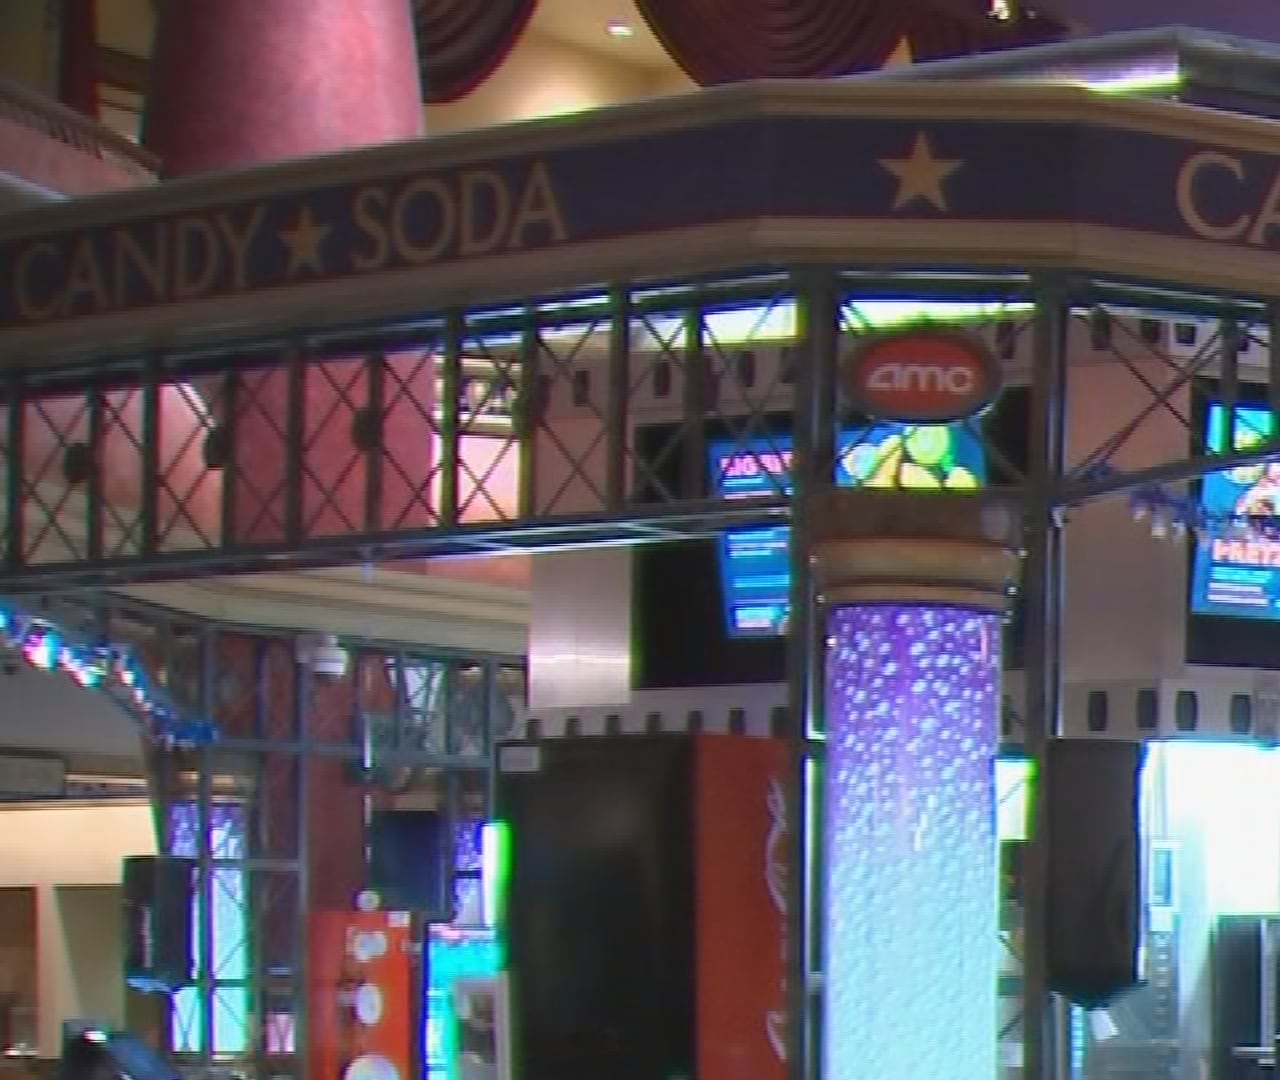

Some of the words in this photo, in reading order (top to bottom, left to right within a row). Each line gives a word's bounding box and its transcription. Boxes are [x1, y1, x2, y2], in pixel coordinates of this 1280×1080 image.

[14, 207, 267, 318] CANDY
[352, 162, 568, 270] SODA
[865, 364, 975, 395] amc
